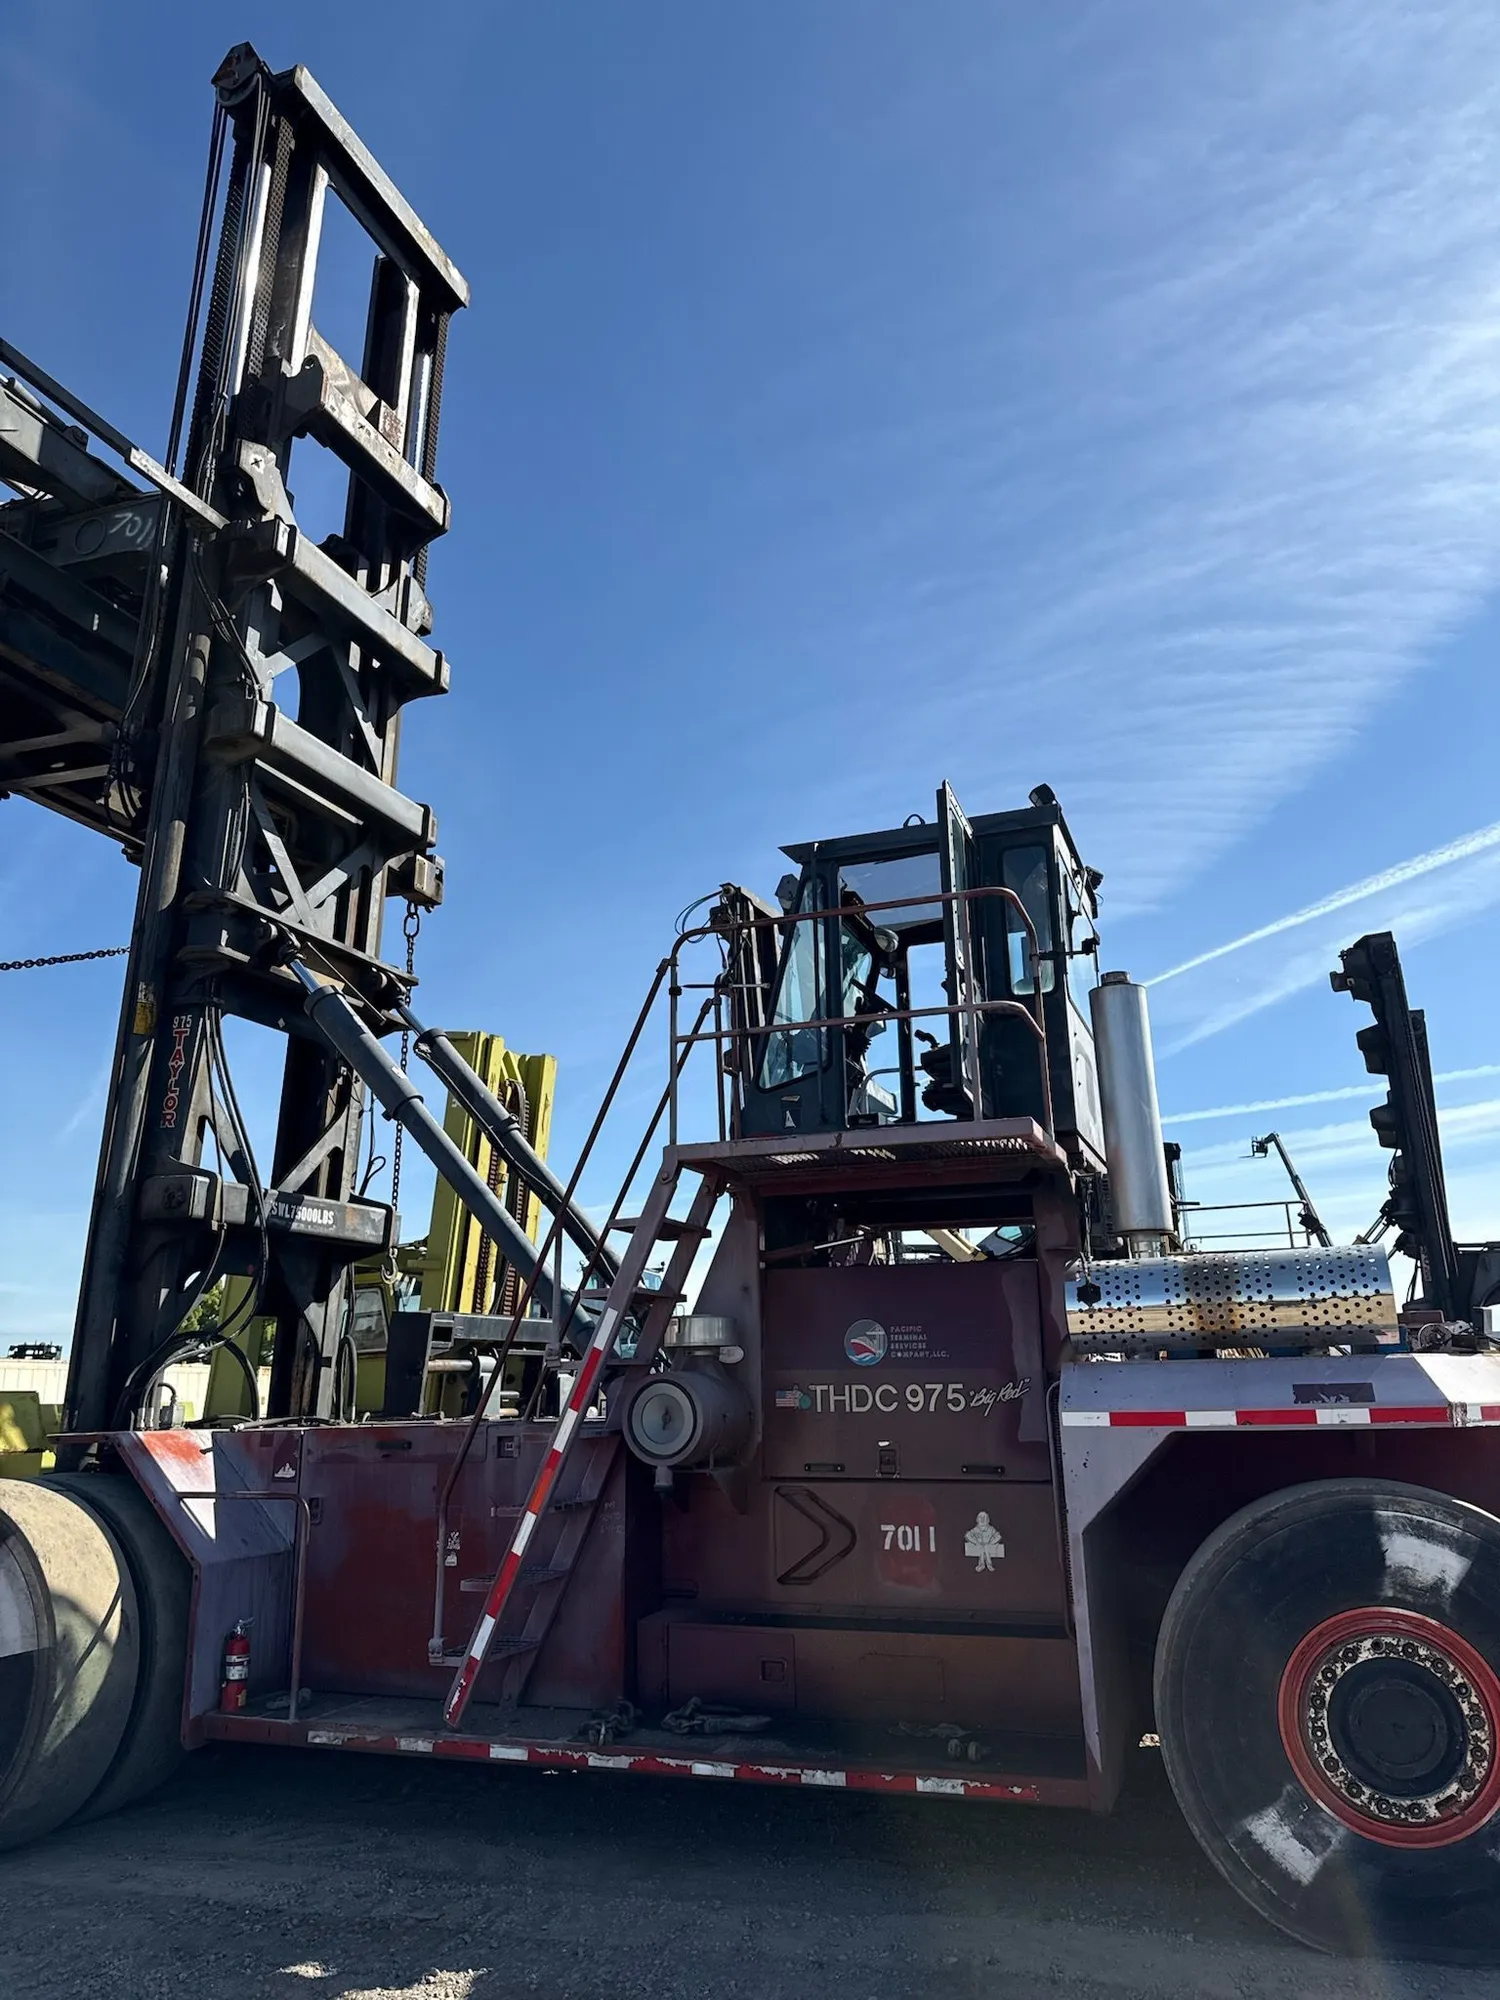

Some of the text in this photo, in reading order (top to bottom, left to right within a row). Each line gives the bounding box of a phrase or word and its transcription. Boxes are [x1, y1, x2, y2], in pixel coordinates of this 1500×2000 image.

[172, 1014, 193, 1029] 975
[160, 1028, 191, 1128] TAYLOR
[890, 1325, 922, 1333] PACIFIC
[890, 1333, 928, 1341] TERMINAL
[890, 1342, 927, 1350] SERVICES
[808, 1383, 898, 1413] THDC
[904, 1383, 966, 1413] 975
[880, 1524, 936, 1552] 7011
